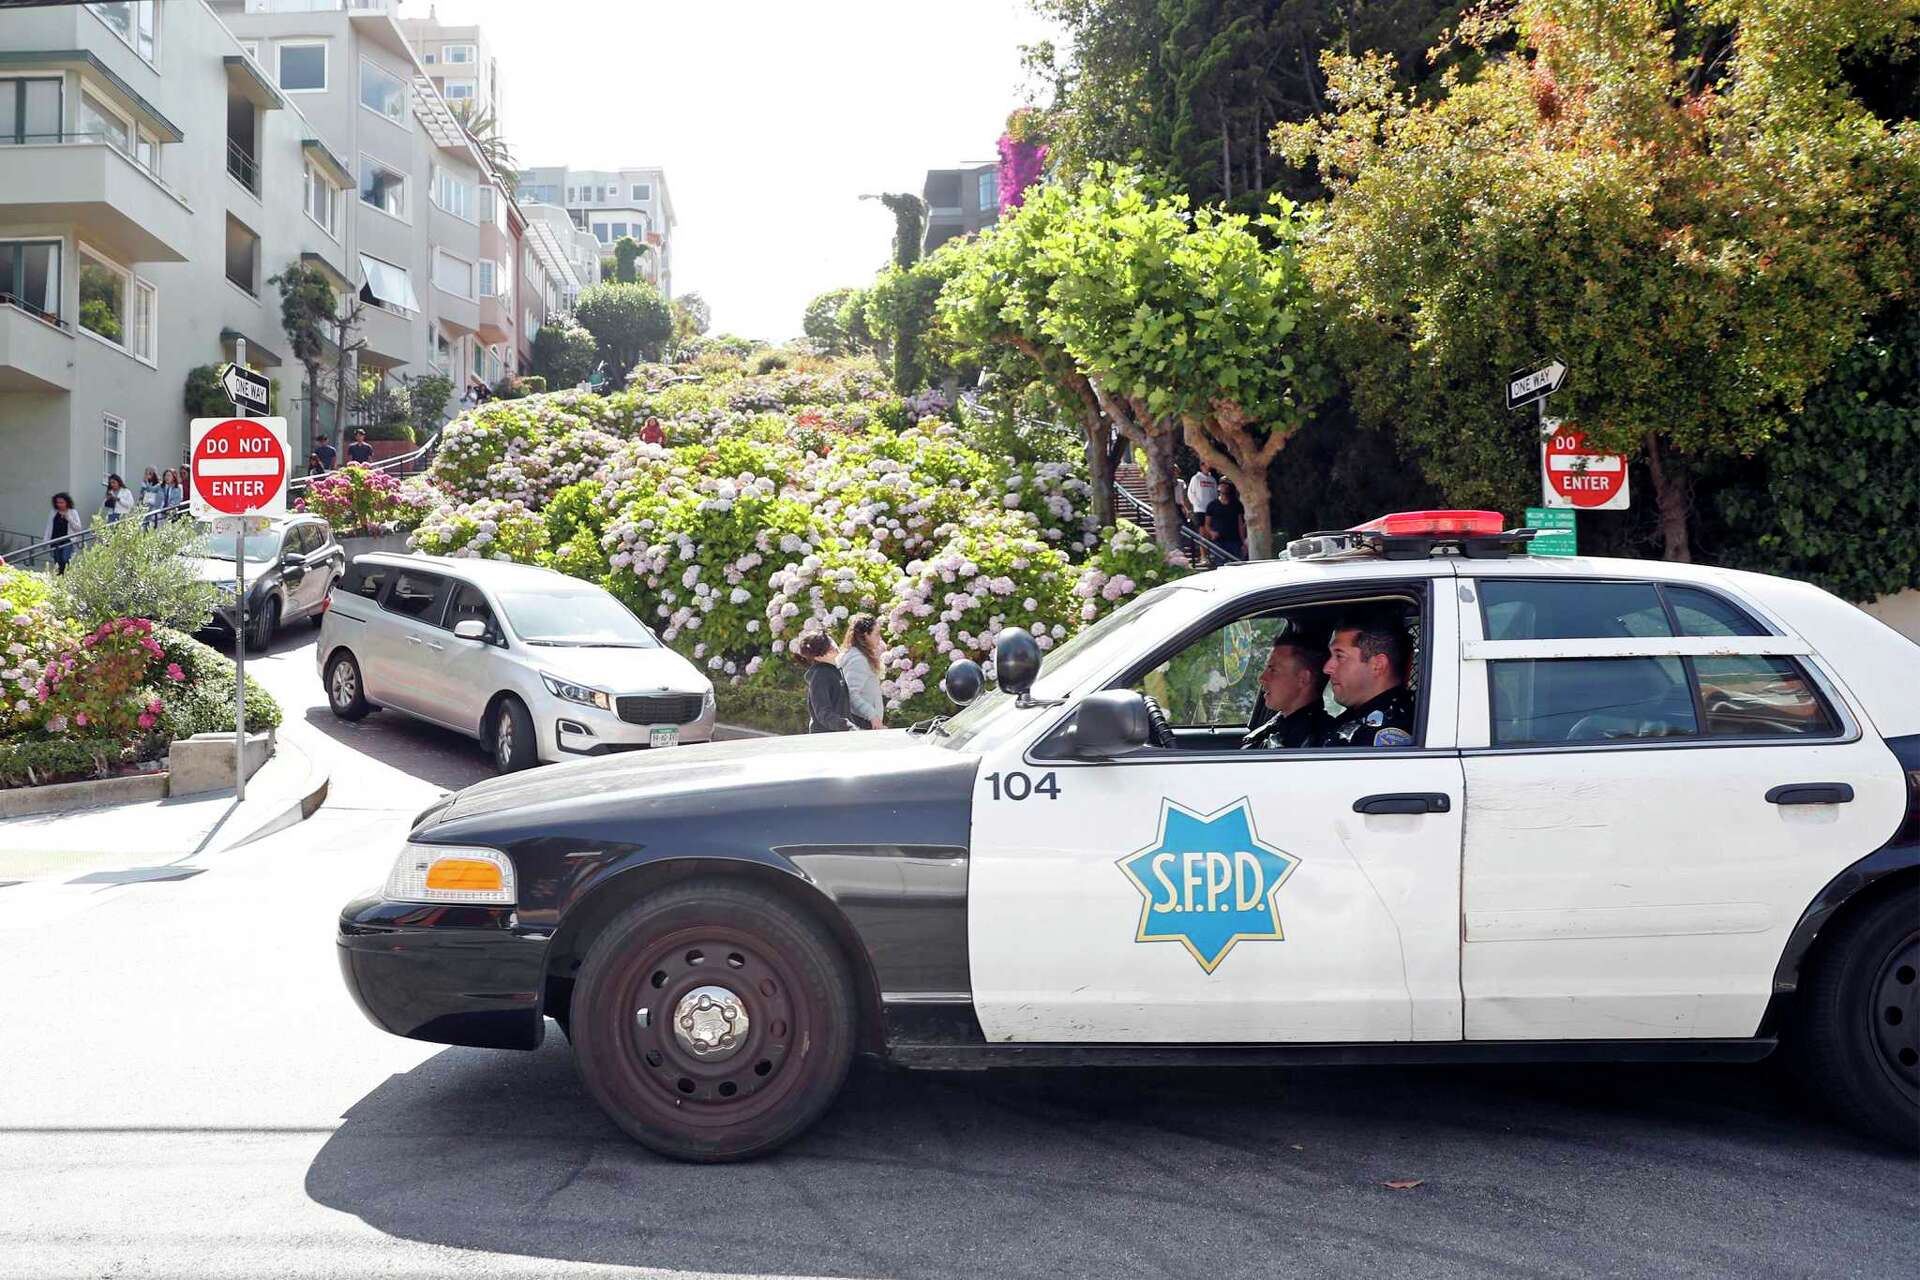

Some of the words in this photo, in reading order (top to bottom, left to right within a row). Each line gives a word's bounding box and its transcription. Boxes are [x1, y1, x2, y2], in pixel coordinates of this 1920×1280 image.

[236, 378, 249, 397] ONE
[251, 385, 265, 402] WAY
[1513, 378, 1531, 396] ONE
[1533, 369, 1550, 387] WAY
[206, 439, 228, 453] DO
[239, 438, 271, 453] NOT
[1556, 436, 1576, 450] DO
[212, 481, 264, 496] ENTER
[1563, 476, 1609, 490] ENTER
[984, 771, 1061, 801] 104
[1152, 851, 1266, 913] S.F.P.D.
